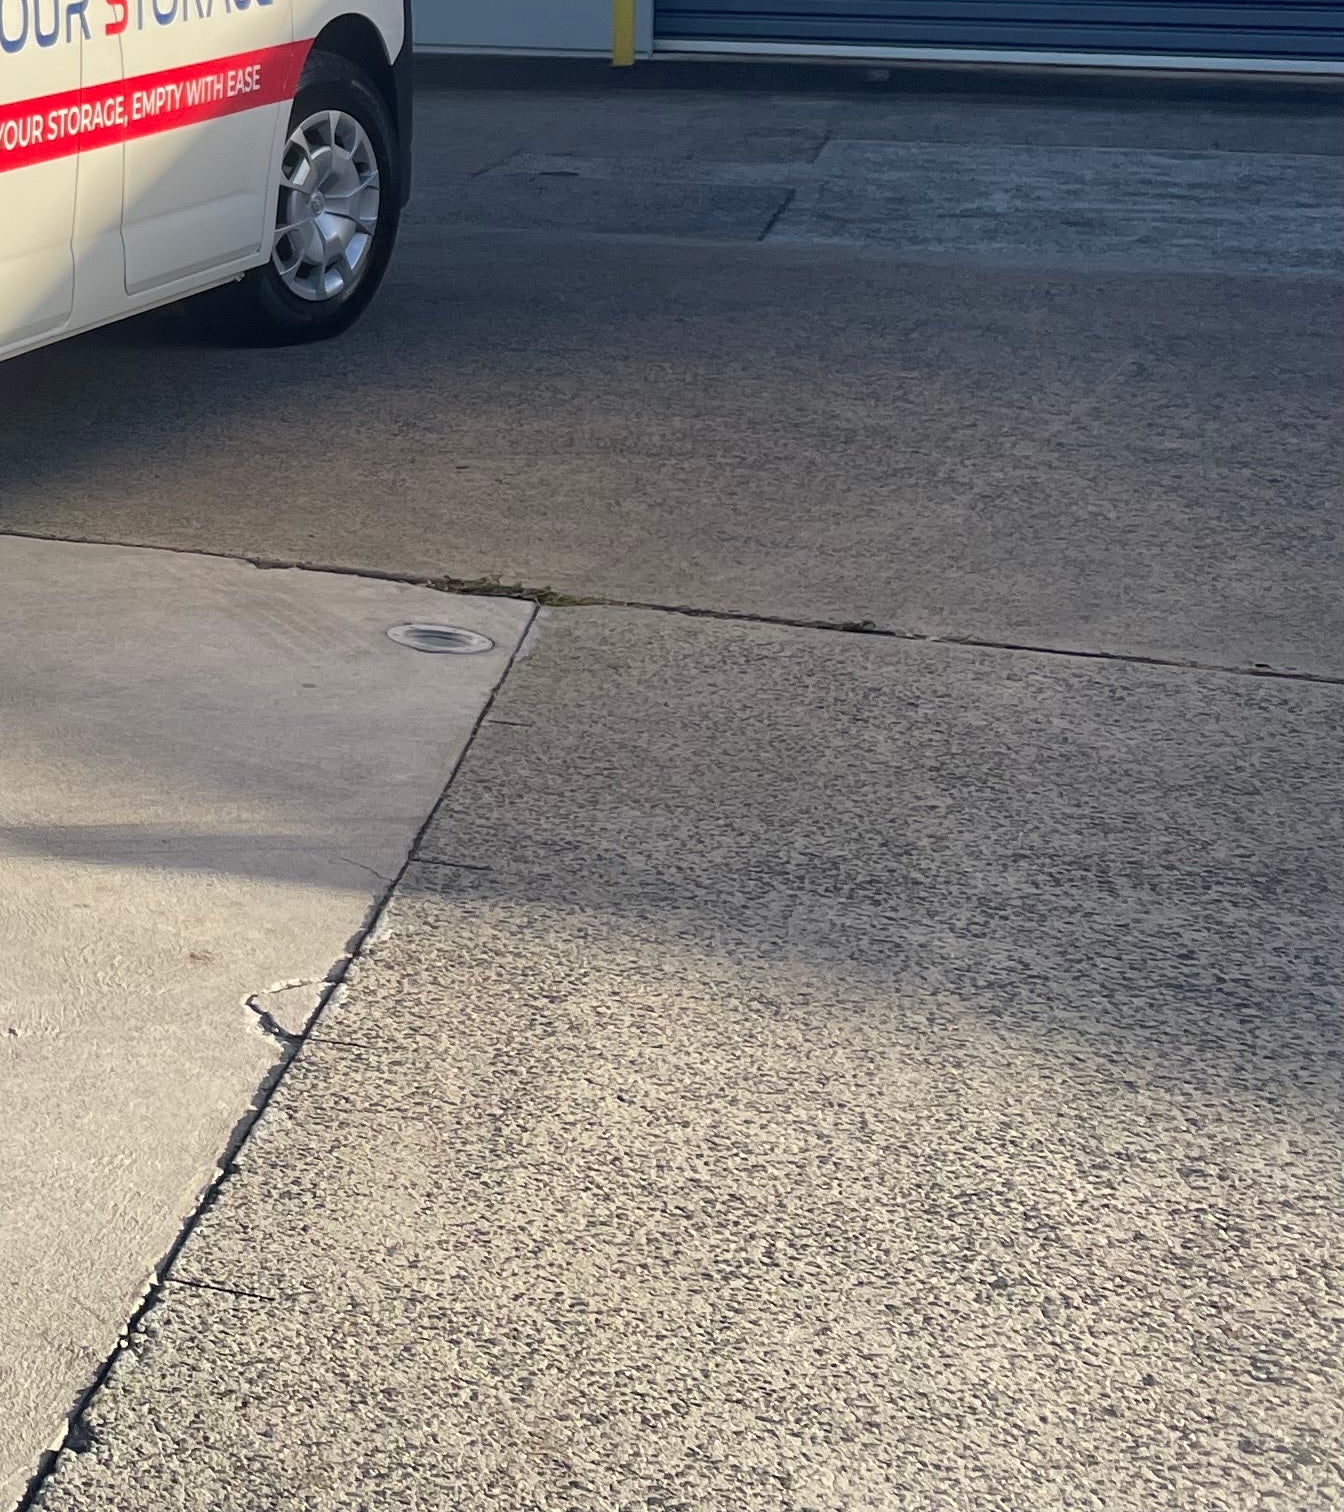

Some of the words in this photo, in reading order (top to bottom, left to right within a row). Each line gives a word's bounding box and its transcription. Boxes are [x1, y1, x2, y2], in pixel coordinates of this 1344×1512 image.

[48, 96, 129, 142] STORAGE,
[132, 85, 185, 122] EMPTY
[185, 74, 224, 108] WITH
[227, 64, 261, 98] EASE
